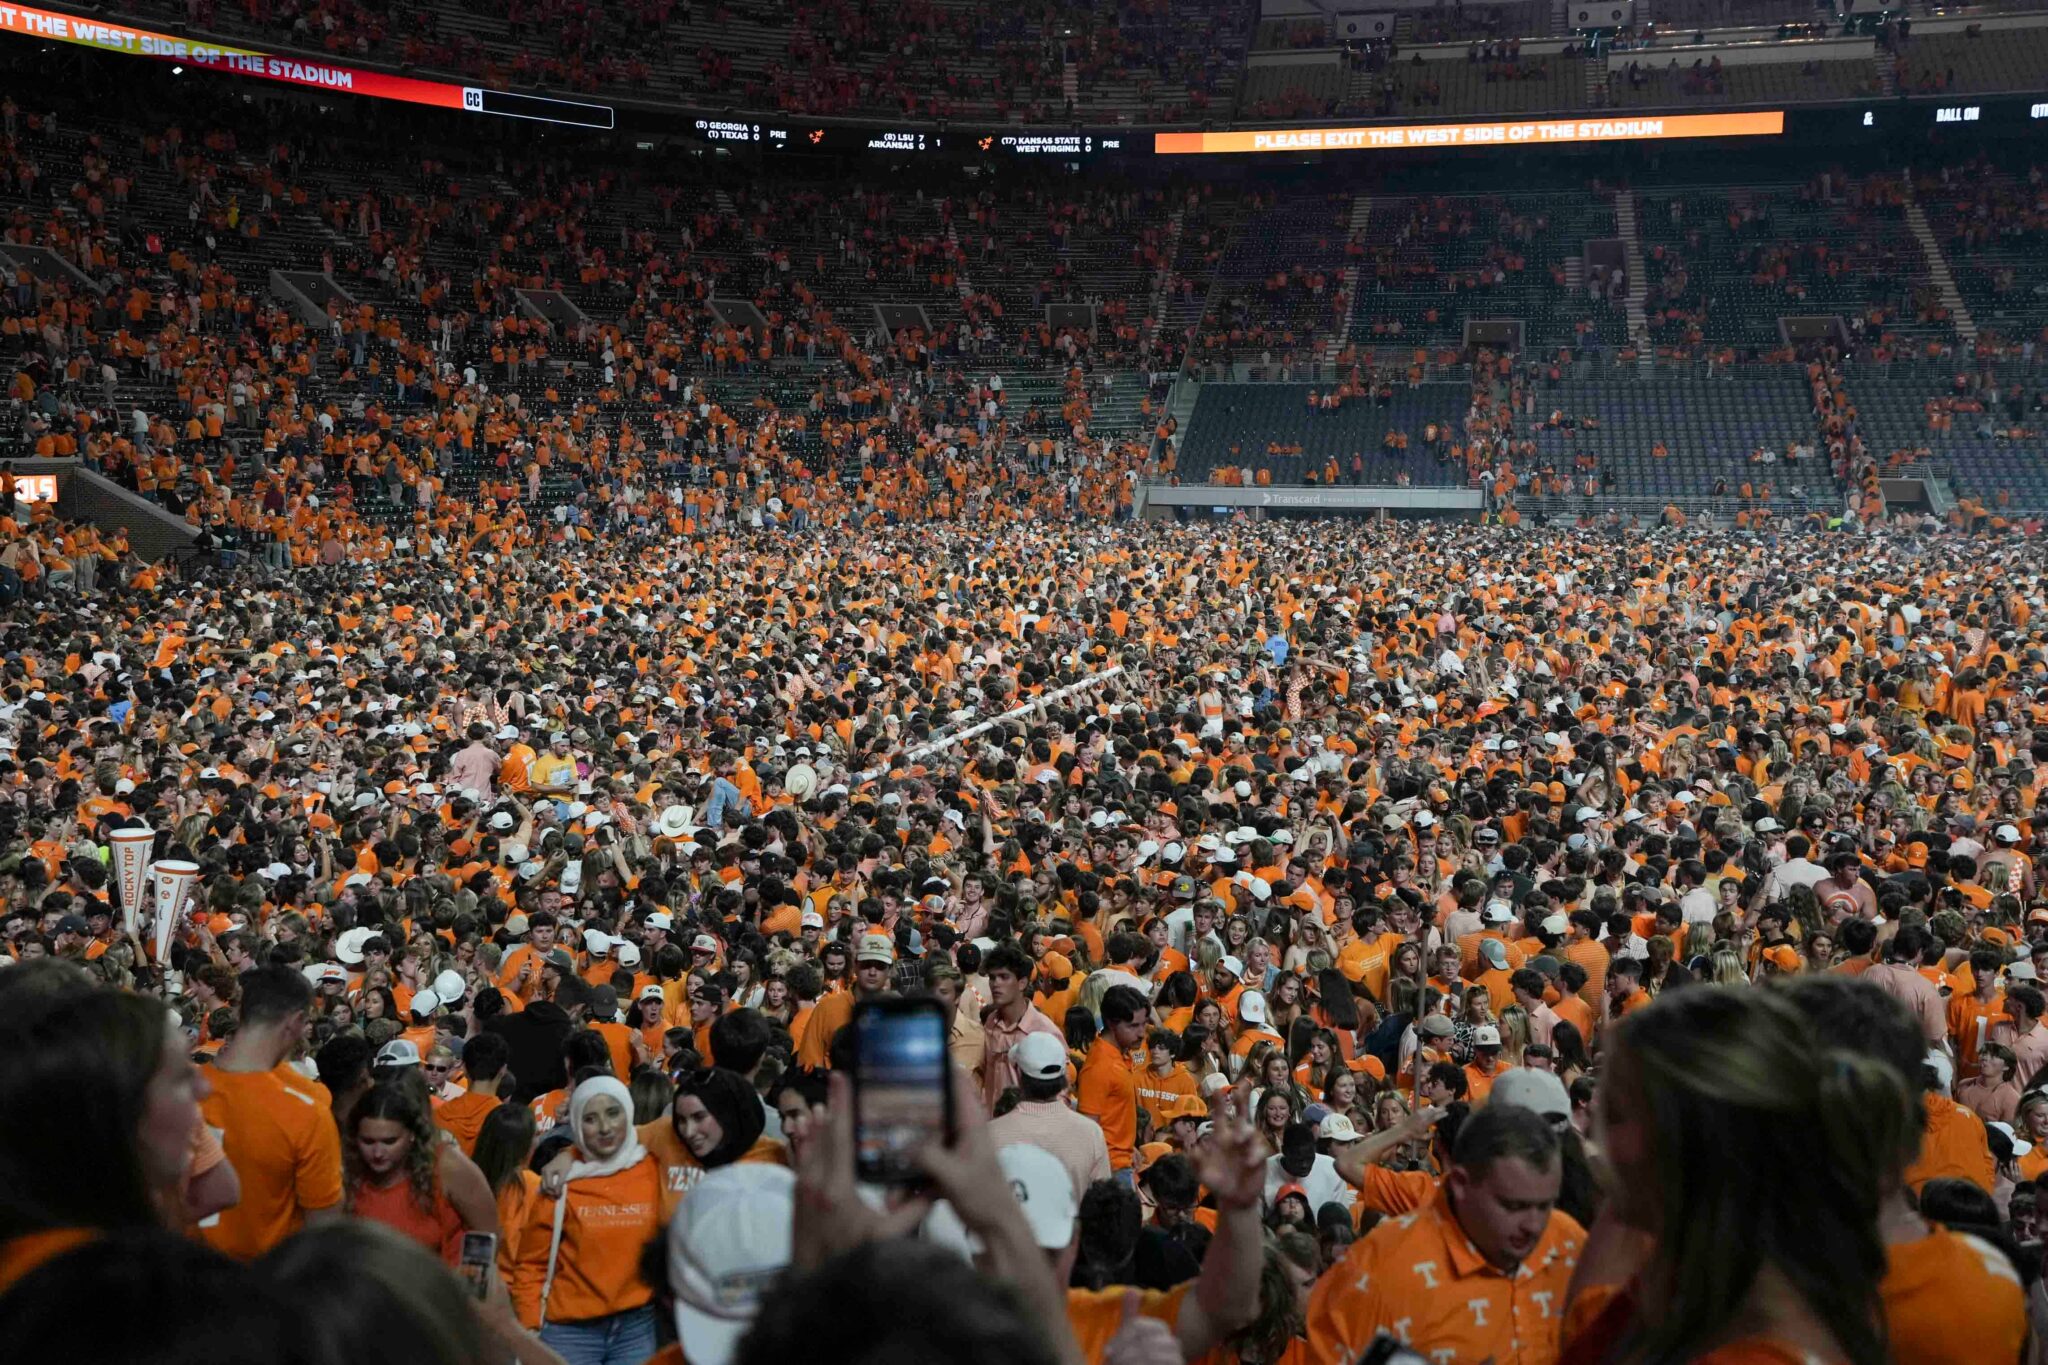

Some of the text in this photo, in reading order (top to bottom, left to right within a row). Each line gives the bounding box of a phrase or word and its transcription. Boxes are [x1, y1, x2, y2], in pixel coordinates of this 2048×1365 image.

[21, 11, 68, 37] THE
[72, 21, 136, 49] WEST
[140, 35, 188, 60] SIDE
[192, 45, 221, 65] OF
[225, 51, 265, 73] THE
[268, 60, 353, 88] STADIUM
[465, 91, 481, 107] CC
[1863, 111, 1873, 125] &
[1936, 106, 1980, 122] BALL ON
[696, 121, 760, 133] (5) GEORGIA 0
[708, 130, 760, 141] (1) TEXAS 0
[770, 130, 787, 139] PRE
[884, 132, 925, 143] (8) LSU 7
[1001, 136, 1092, 146] (17) KANSAS STATE 0
[1254, 121, 1663, 148] PLEASE EXIT THE WEST SIDE OF THE STADIUM
[868, 140, 926, 151] ARKANSAS 0
[1016, 144, 1092, 153] WEST VIRGINIA 0
[1103, 140, 1120, 148] PRE
[1273, 493, 1320, 504] Transcard
[124, 847, 134, 906] ROCKY TOP
[1976, 1015, 1988, 1052] 1
[1413, 1261, 1439, 1289] T
[1468, 1298, 1490, 1326] T
[1531, 1291, 1553, 1319] T
